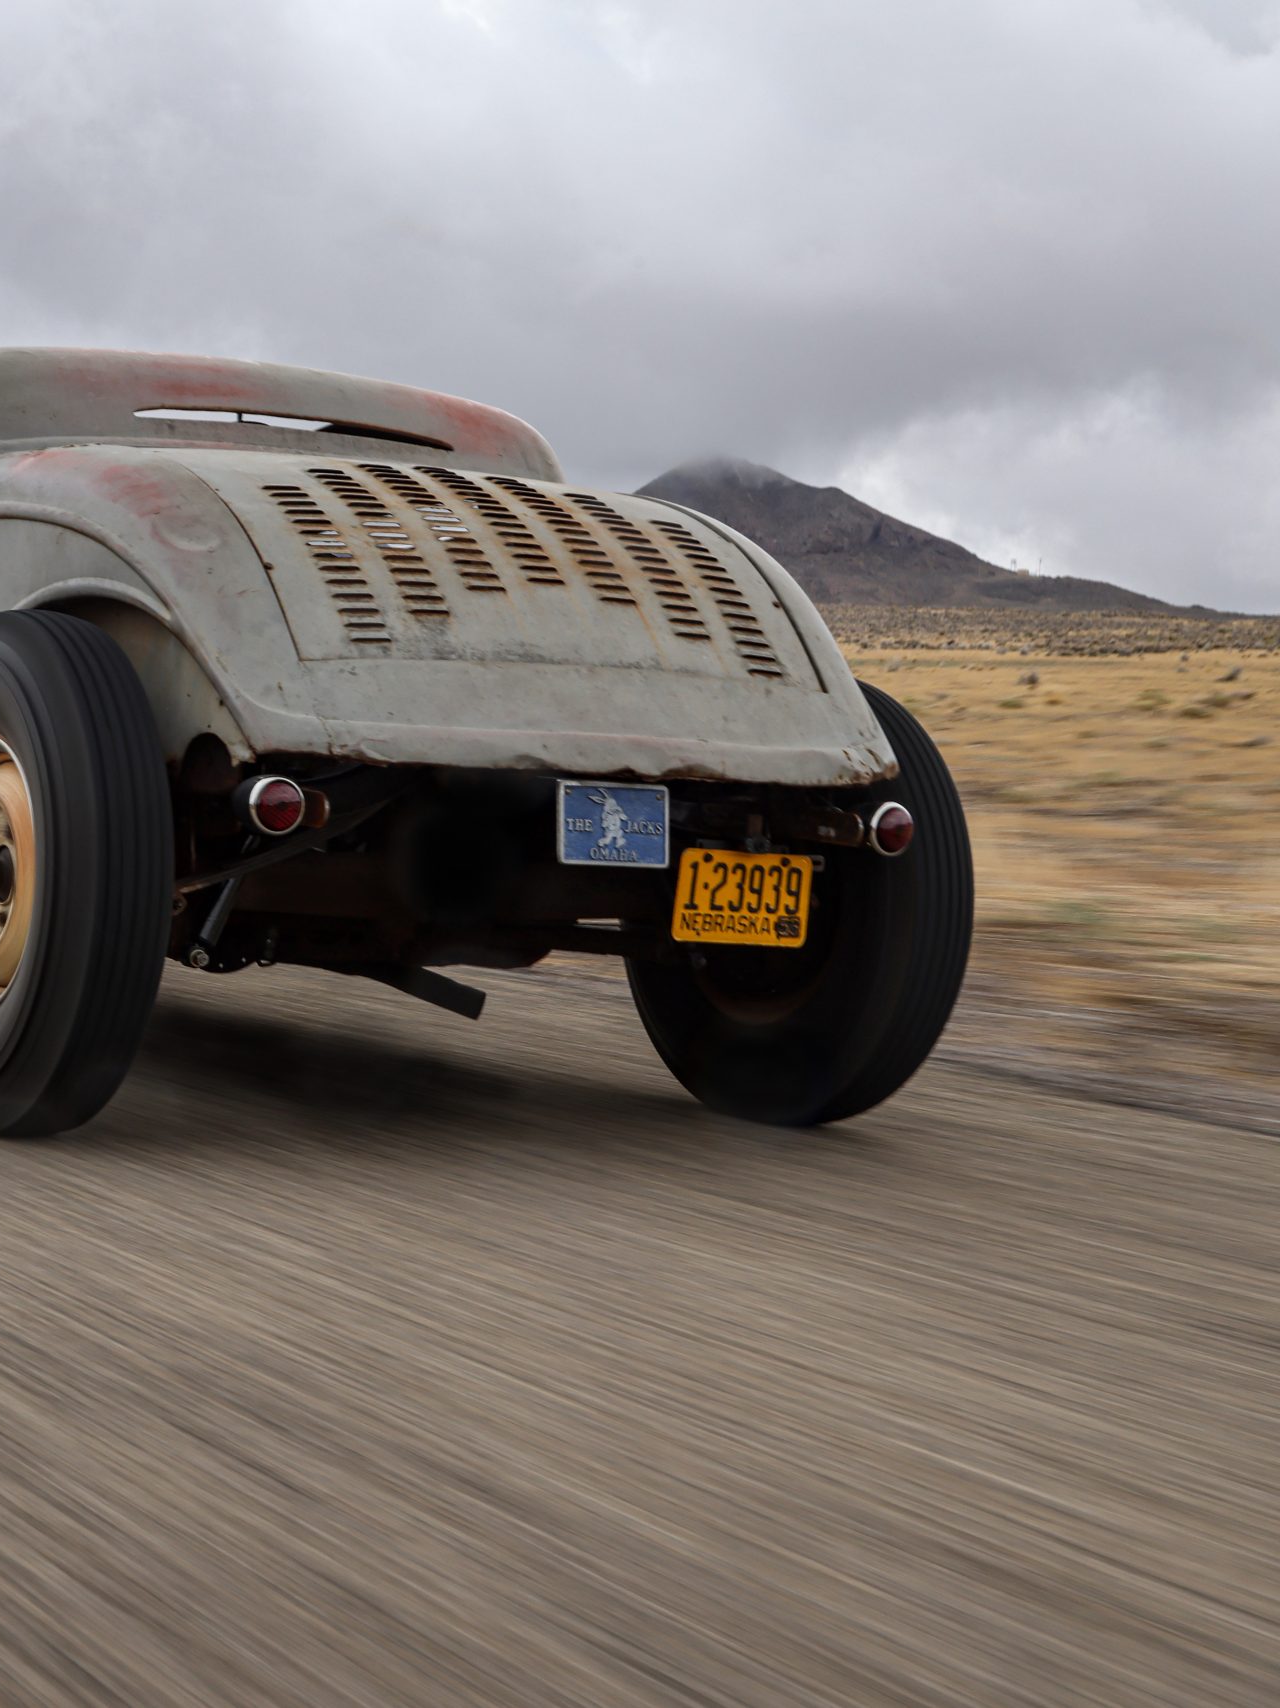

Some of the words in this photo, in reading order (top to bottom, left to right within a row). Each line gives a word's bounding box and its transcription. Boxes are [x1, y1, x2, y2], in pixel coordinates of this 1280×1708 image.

[566, 818, 593, 832] THE
[624, 820, 664, 835] JACKS
[590, 847, 638, 862] OMAHA
[680, 912, 771, 935] NEBRASKA
